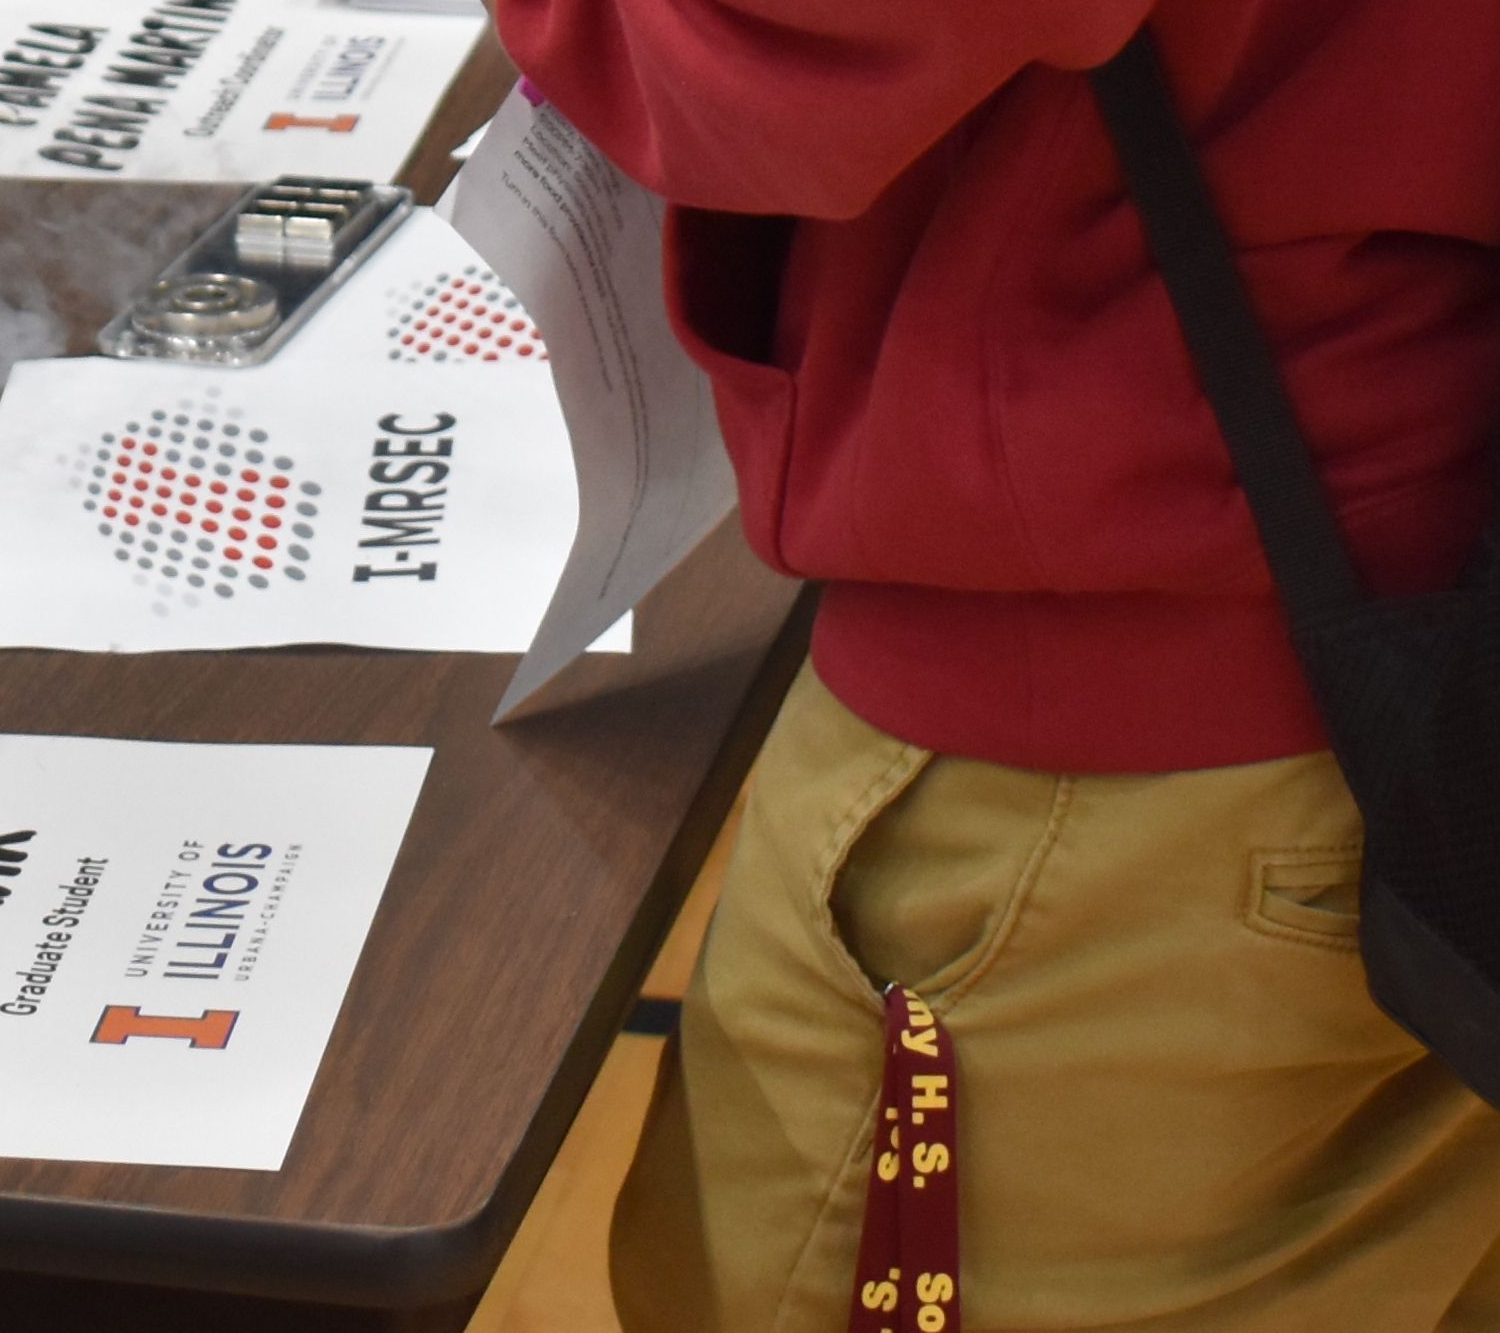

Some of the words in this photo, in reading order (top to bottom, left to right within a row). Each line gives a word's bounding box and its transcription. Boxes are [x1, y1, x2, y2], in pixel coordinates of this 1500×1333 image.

[312, 36, 386, 101] ILLINOIS
[353, 411, 456, 582] I-MRSEC
[0, 931, 73, 1017] Graduate
[42, 855, 110, 929] Student
[124, 868, 194, 978] UNIVERSITY
[178, 839, 205, 862] OF
[162, 842, 273, 981] ILLINOIS
[234, 843, 304, 983] URBANA-CHAMPAIGN
[911, 1074, 949, 1125] H.
[912, 1141, 950, 1189] S.
